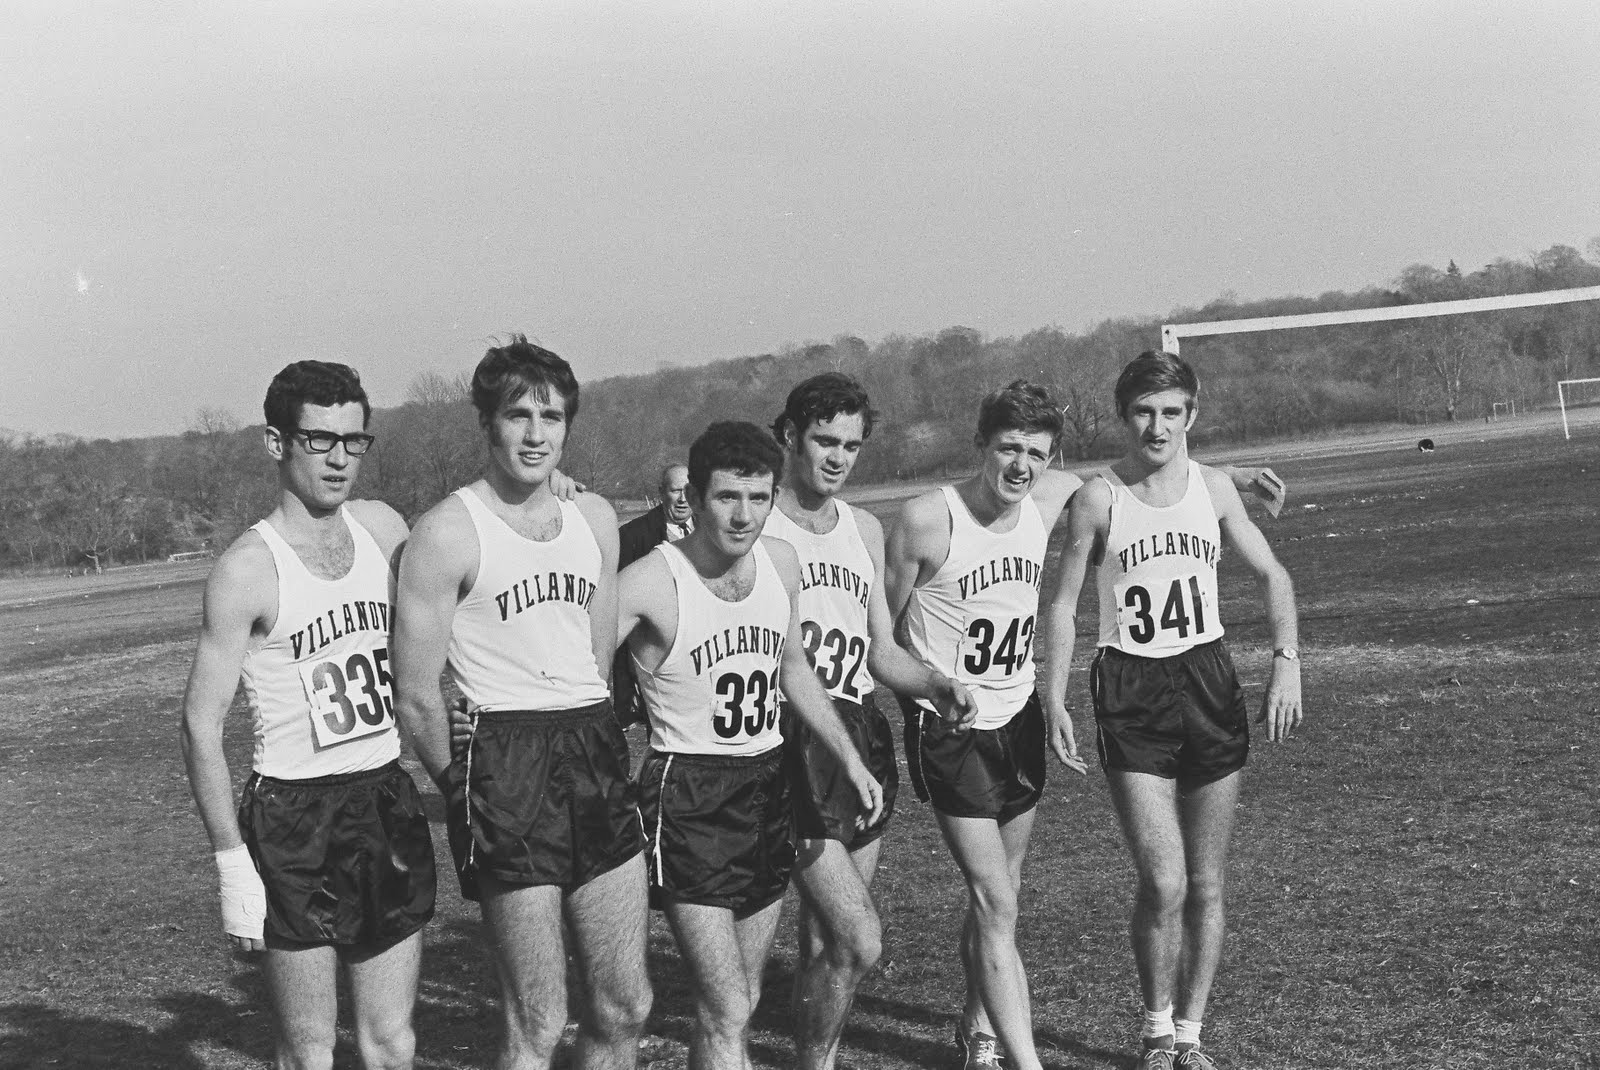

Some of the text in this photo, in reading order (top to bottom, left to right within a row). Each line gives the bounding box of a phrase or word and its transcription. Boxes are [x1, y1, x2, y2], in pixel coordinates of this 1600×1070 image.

[1119, 532, 1215, 573] VILLANOVA
[495, 572, 597, 620] VILLANOV
[1124, 575, 1205, 644] 341
[964, 615, 1035, 676] 343
[312, 648, 395, 735] 335
